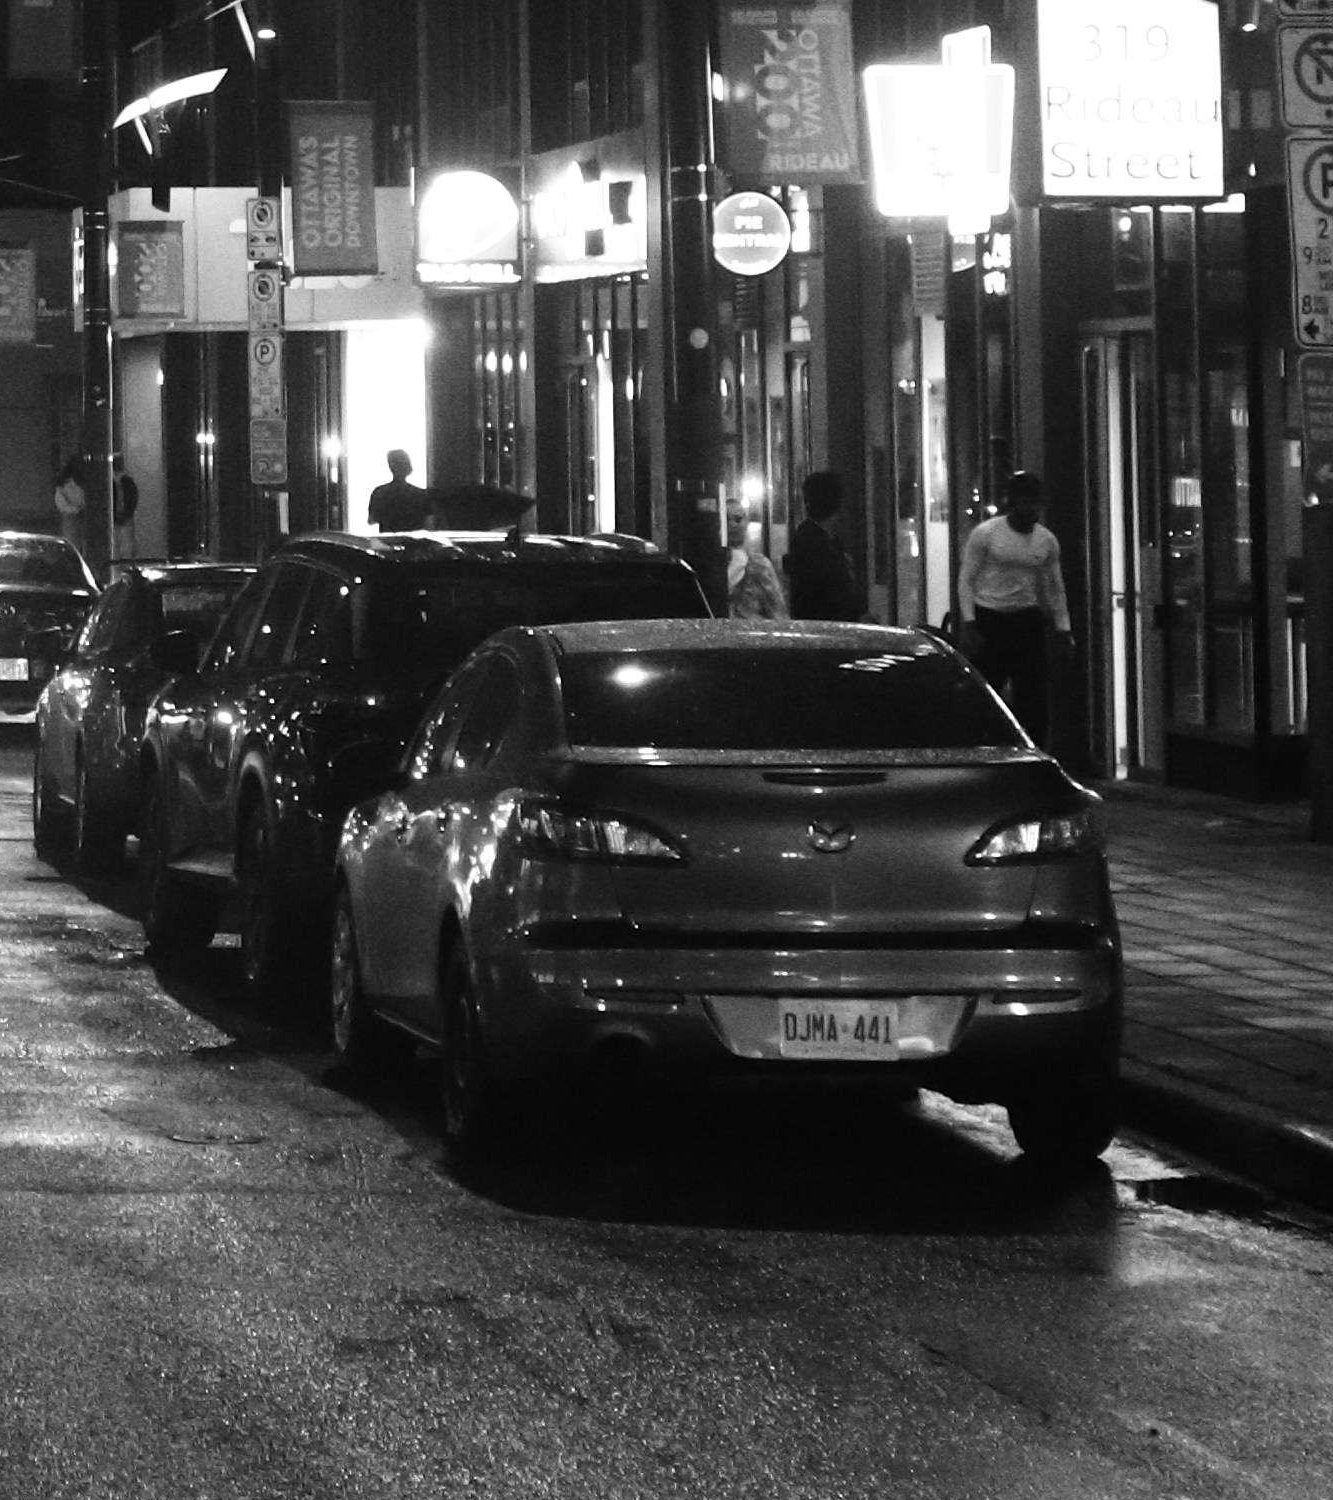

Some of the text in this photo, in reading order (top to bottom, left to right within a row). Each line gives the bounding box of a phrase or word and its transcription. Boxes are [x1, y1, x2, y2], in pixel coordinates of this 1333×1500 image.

[1083, 24, 1170, 62] 319
[798, 28, 824, 138] OTTAWA
[1046, 82, 1219, 124] Rideau
[768, 151, 851, 172] RIDEAU
[1049, 140, 1203, 180] Street
[321, 136, 343, 248] ORIGINAL
[343, 134, 361, 248] DOWNTOWN
[734, 215, 763, 230] PIE
[853, 1014, 892, 1045] 441
